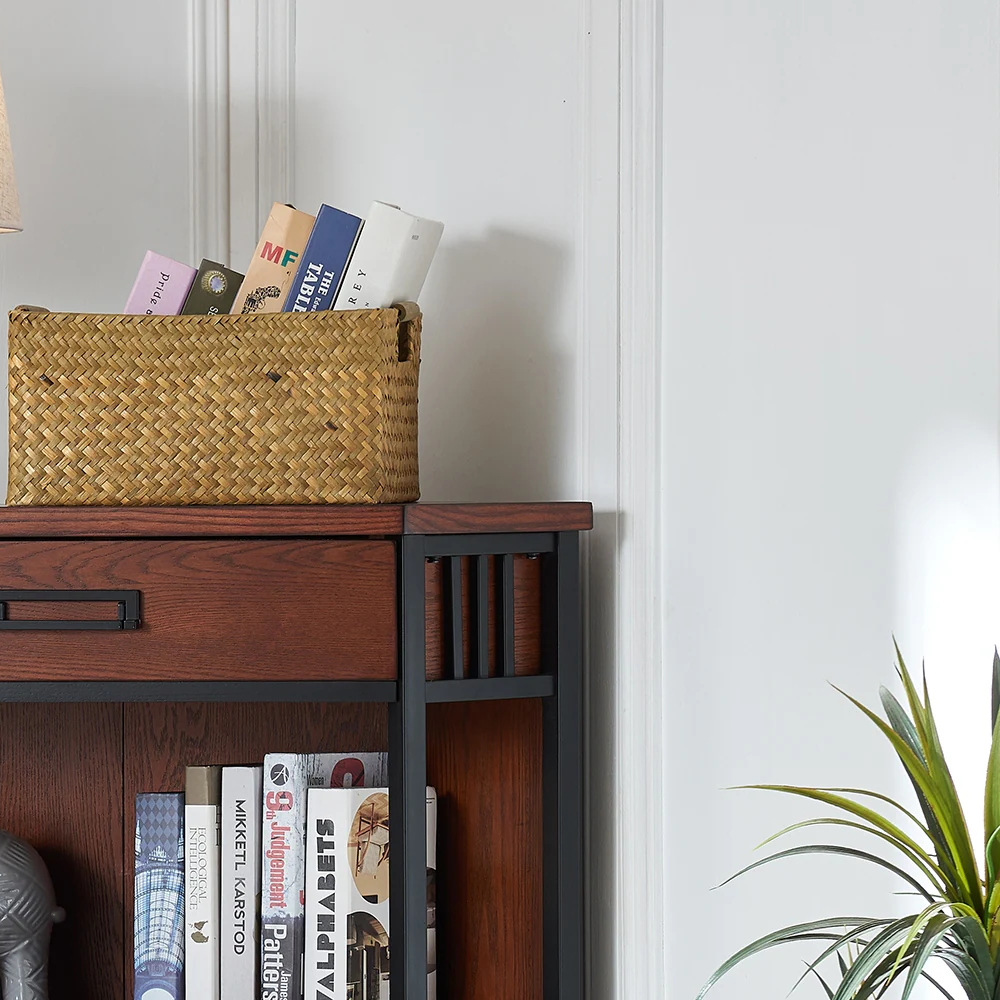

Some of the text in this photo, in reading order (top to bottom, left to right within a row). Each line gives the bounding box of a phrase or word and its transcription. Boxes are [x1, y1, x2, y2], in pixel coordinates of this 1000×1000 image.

[260, 241, 299, 268] MF
[317, 270, 335, 297] THE
[233, 800, 247, 955] MIKKETL KARSTOD
[266, 821, 291, 909] Judgement
[315, 818, 336, 993] ALPHABETS
